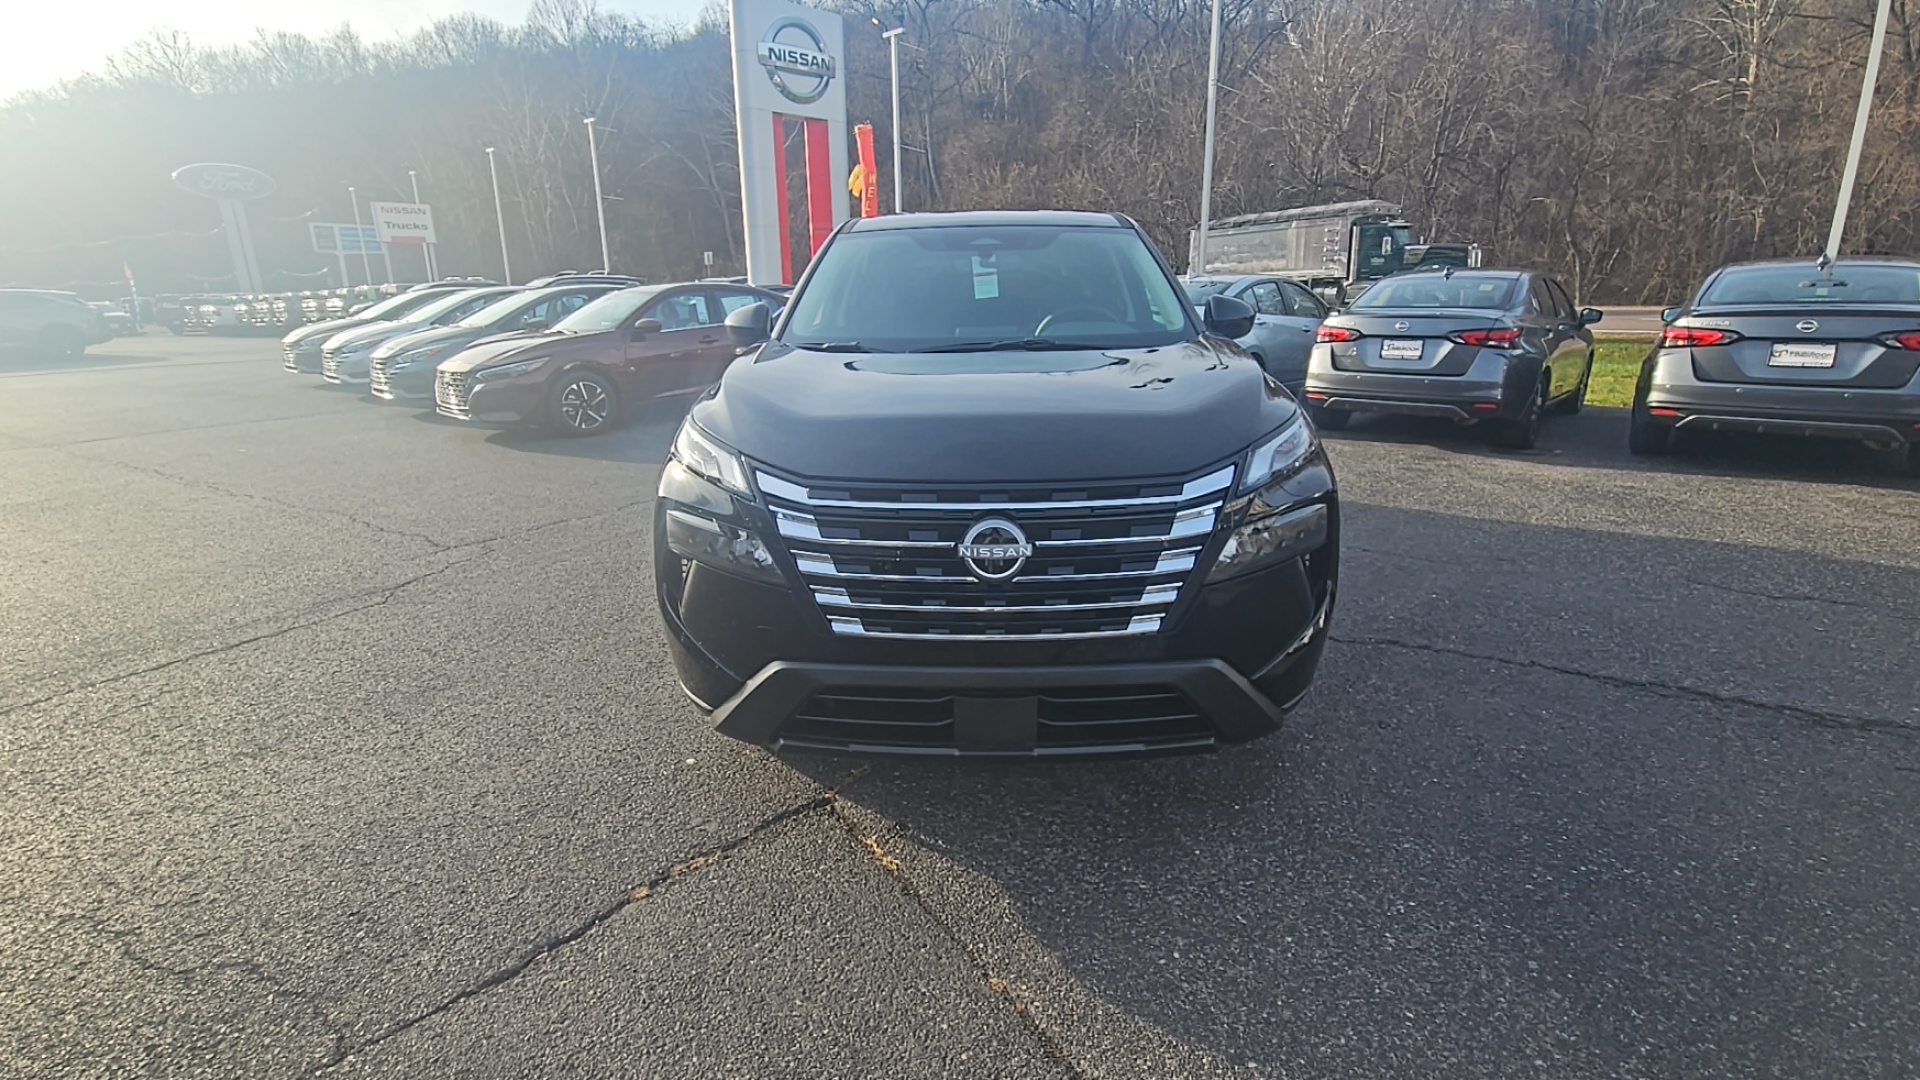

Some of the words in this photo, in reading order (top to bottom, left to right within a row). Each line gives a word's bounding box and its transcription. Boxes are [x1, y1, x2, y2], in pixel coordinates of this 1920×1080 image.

[768, 47, 831, 72] NISSAN
[199, 169, 257, 193] Ford
[380, 205, 427, 216] NISSAN
[383, 220, 429, 231] Trucks
[959, 546, 1030, 558] NISSAN
